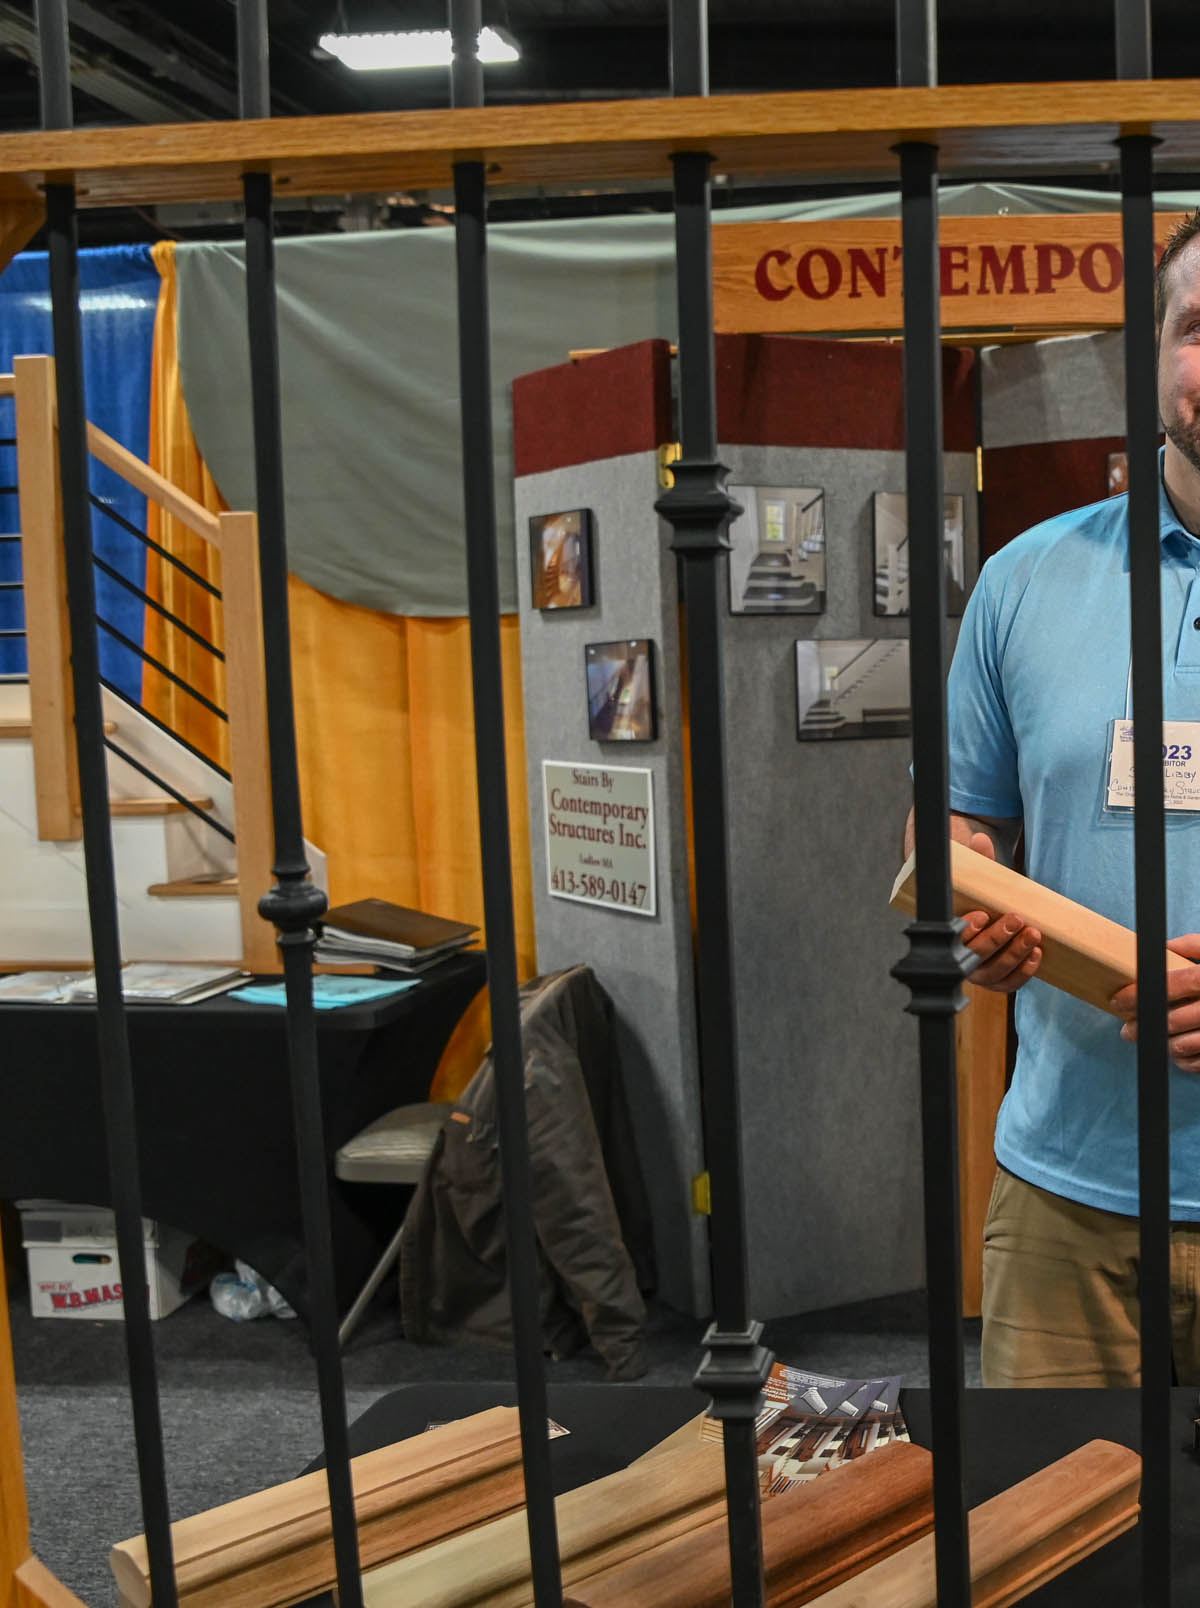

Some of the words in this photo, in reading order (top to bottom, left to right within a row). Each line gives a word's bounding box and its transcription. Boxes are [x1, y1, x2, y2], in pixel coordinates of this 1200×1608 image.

[754, 242, 1124, 301] CONEMPO
[1161, 744, 1192, 760] 023
[572, 768, 599, 787] Stairs
[602, 771, 614, 793] By
[551, 788, 649, 829] Contemporary
[549, 814, 615, 845] Structures
[619, 823, 647, 849] Inc.
[552, 866, 648, 907] 413-589-0147
